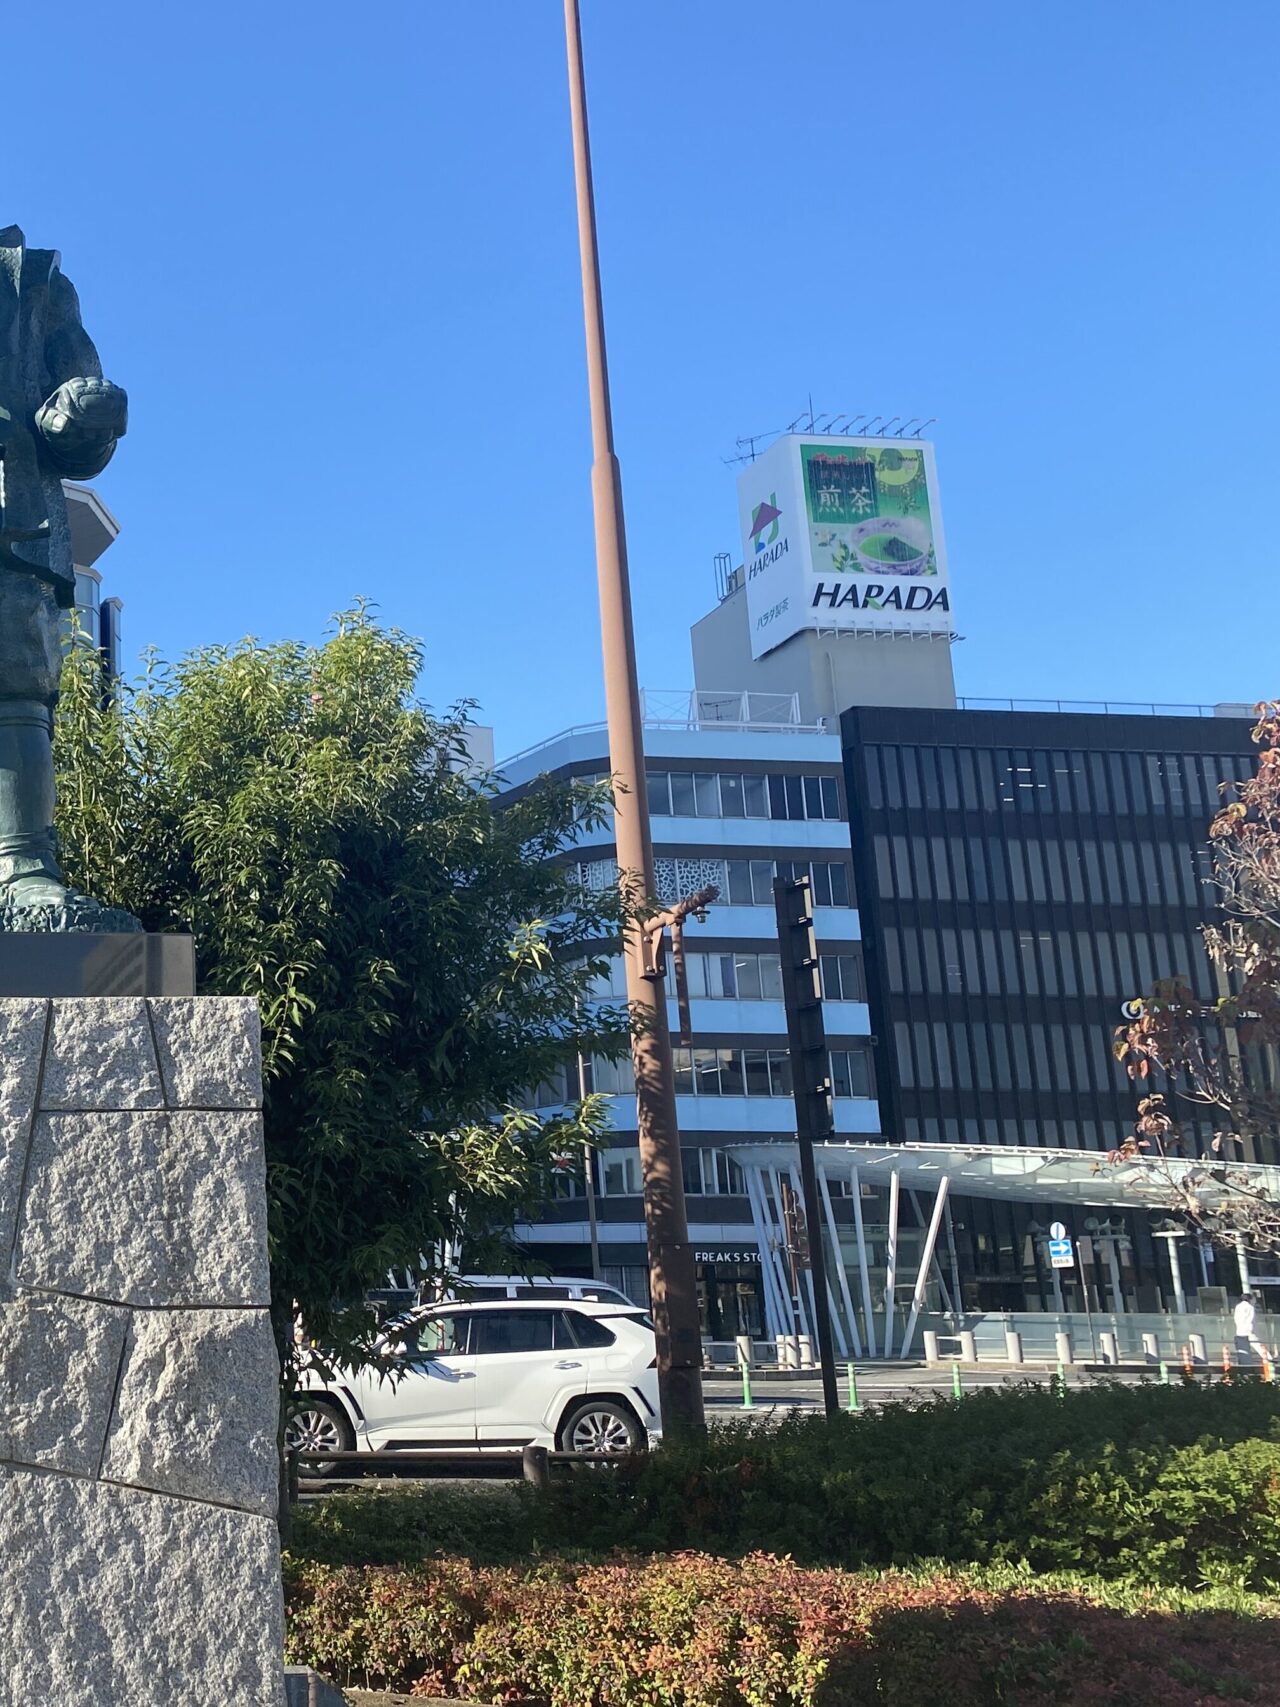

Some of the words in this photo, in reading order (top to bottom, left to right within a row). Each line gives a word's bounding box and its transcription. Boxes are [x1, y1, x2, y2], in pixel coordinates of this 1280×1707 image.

[817, 484, 874, 515] 煎茶
[748, 537, 789, 581] HARADA
[812, 582, 950, 612] HARADA
